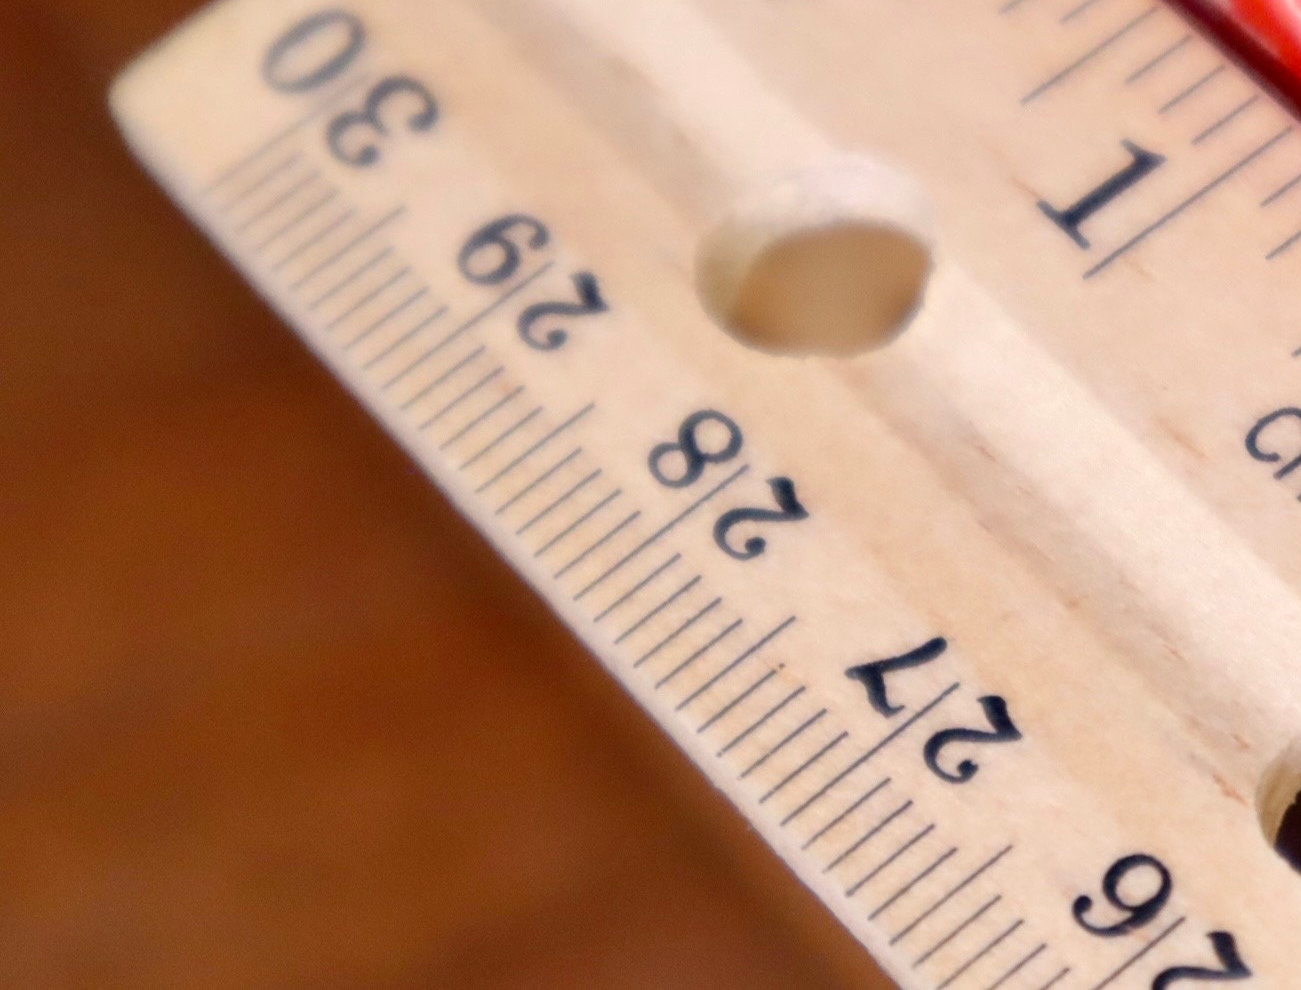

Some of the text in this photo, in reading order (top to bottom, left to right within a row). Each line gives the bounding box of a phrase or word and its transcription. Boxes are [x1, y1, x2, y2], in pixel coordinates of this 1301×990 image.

[261, 9, 439, 167] 30
[1035, 138, 1168, 251] 1
[456, 213, 610, 352] 29
[647, 410, 810, 560] 28
[845, 636, 1023, 784] 27
